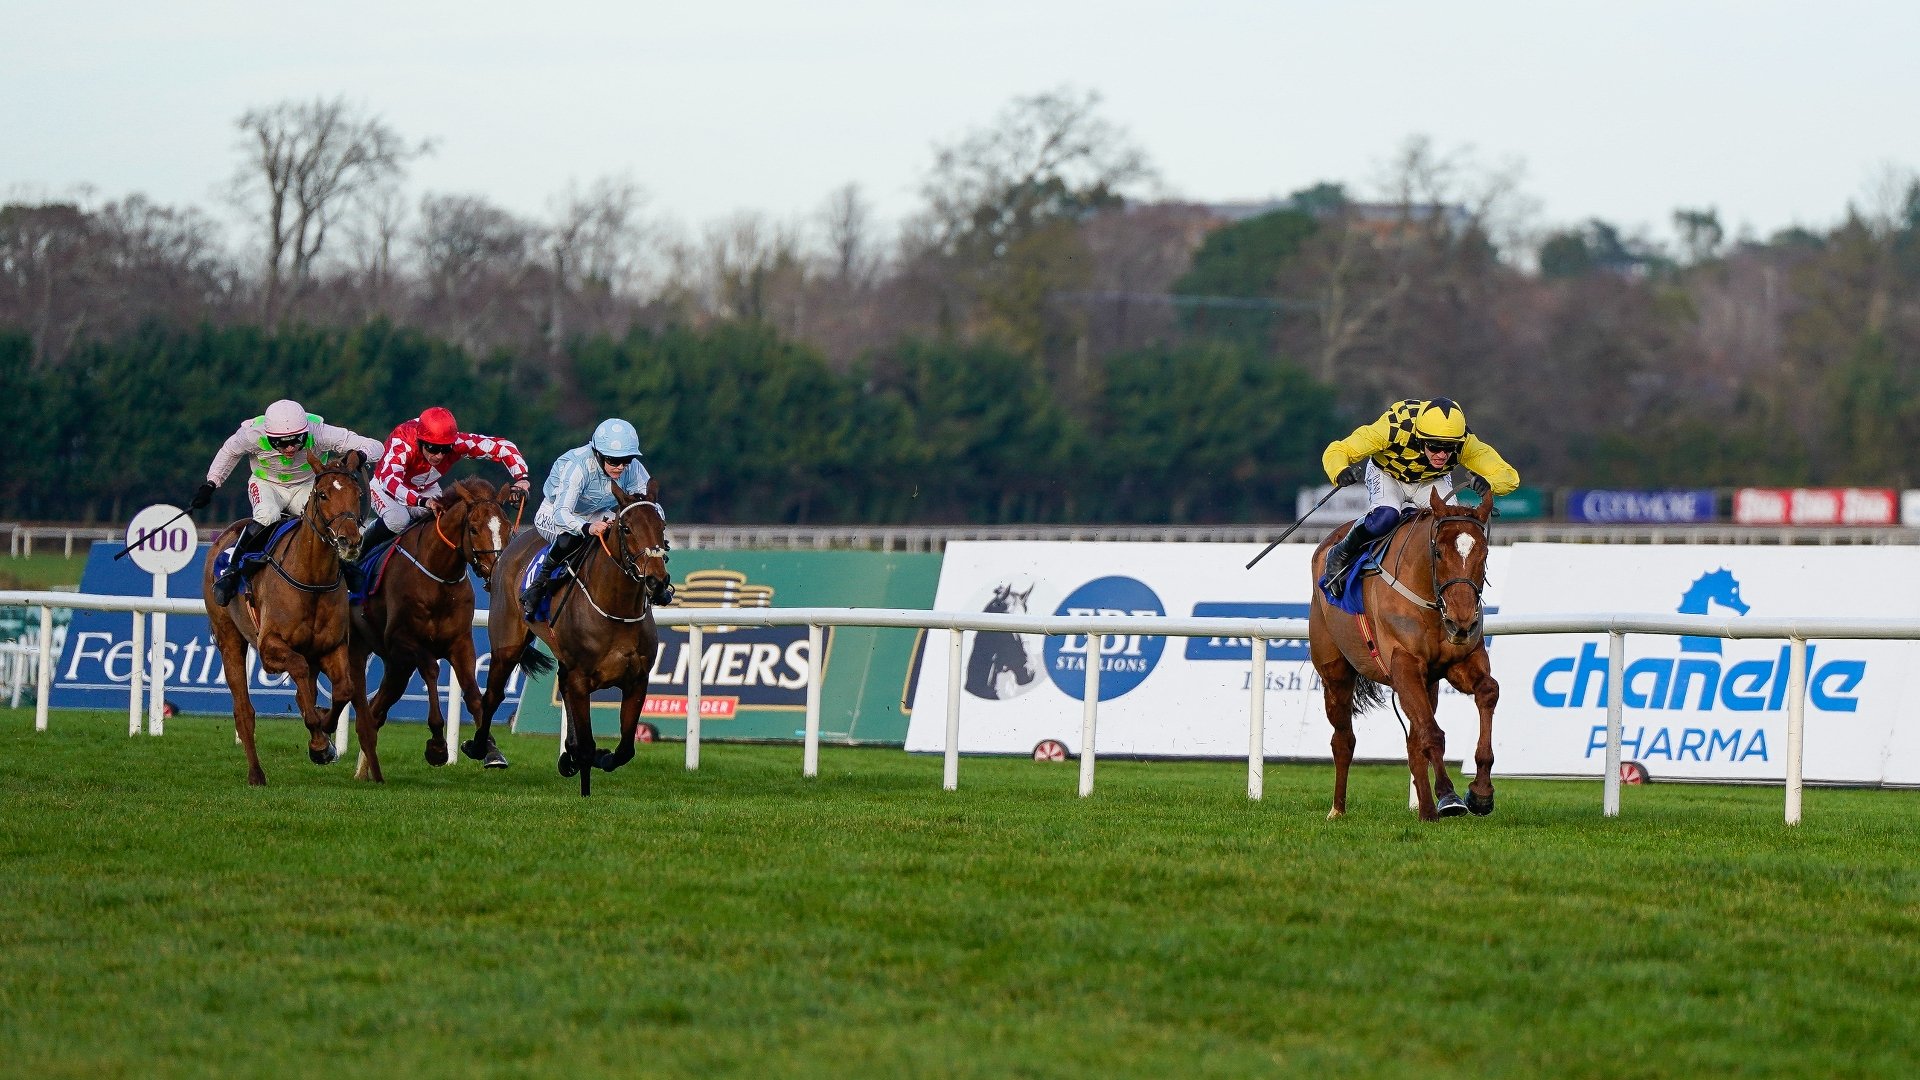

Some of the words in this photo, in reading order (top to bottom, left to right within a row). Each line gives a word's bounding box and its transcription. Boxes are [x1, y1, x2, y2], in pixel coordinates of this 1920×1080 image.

[136, 527, 188, 552] 100
[649, 639, 810, 690] LMERS
[1056, 656, 1147, 673] STALIONS
[1532, 642, 1867, 712] chanele
[1241, 671, 1301, 690] Iish
[643, 701, 681, 713] RISH
[1585, 725, 1768, 762] PHARMA
